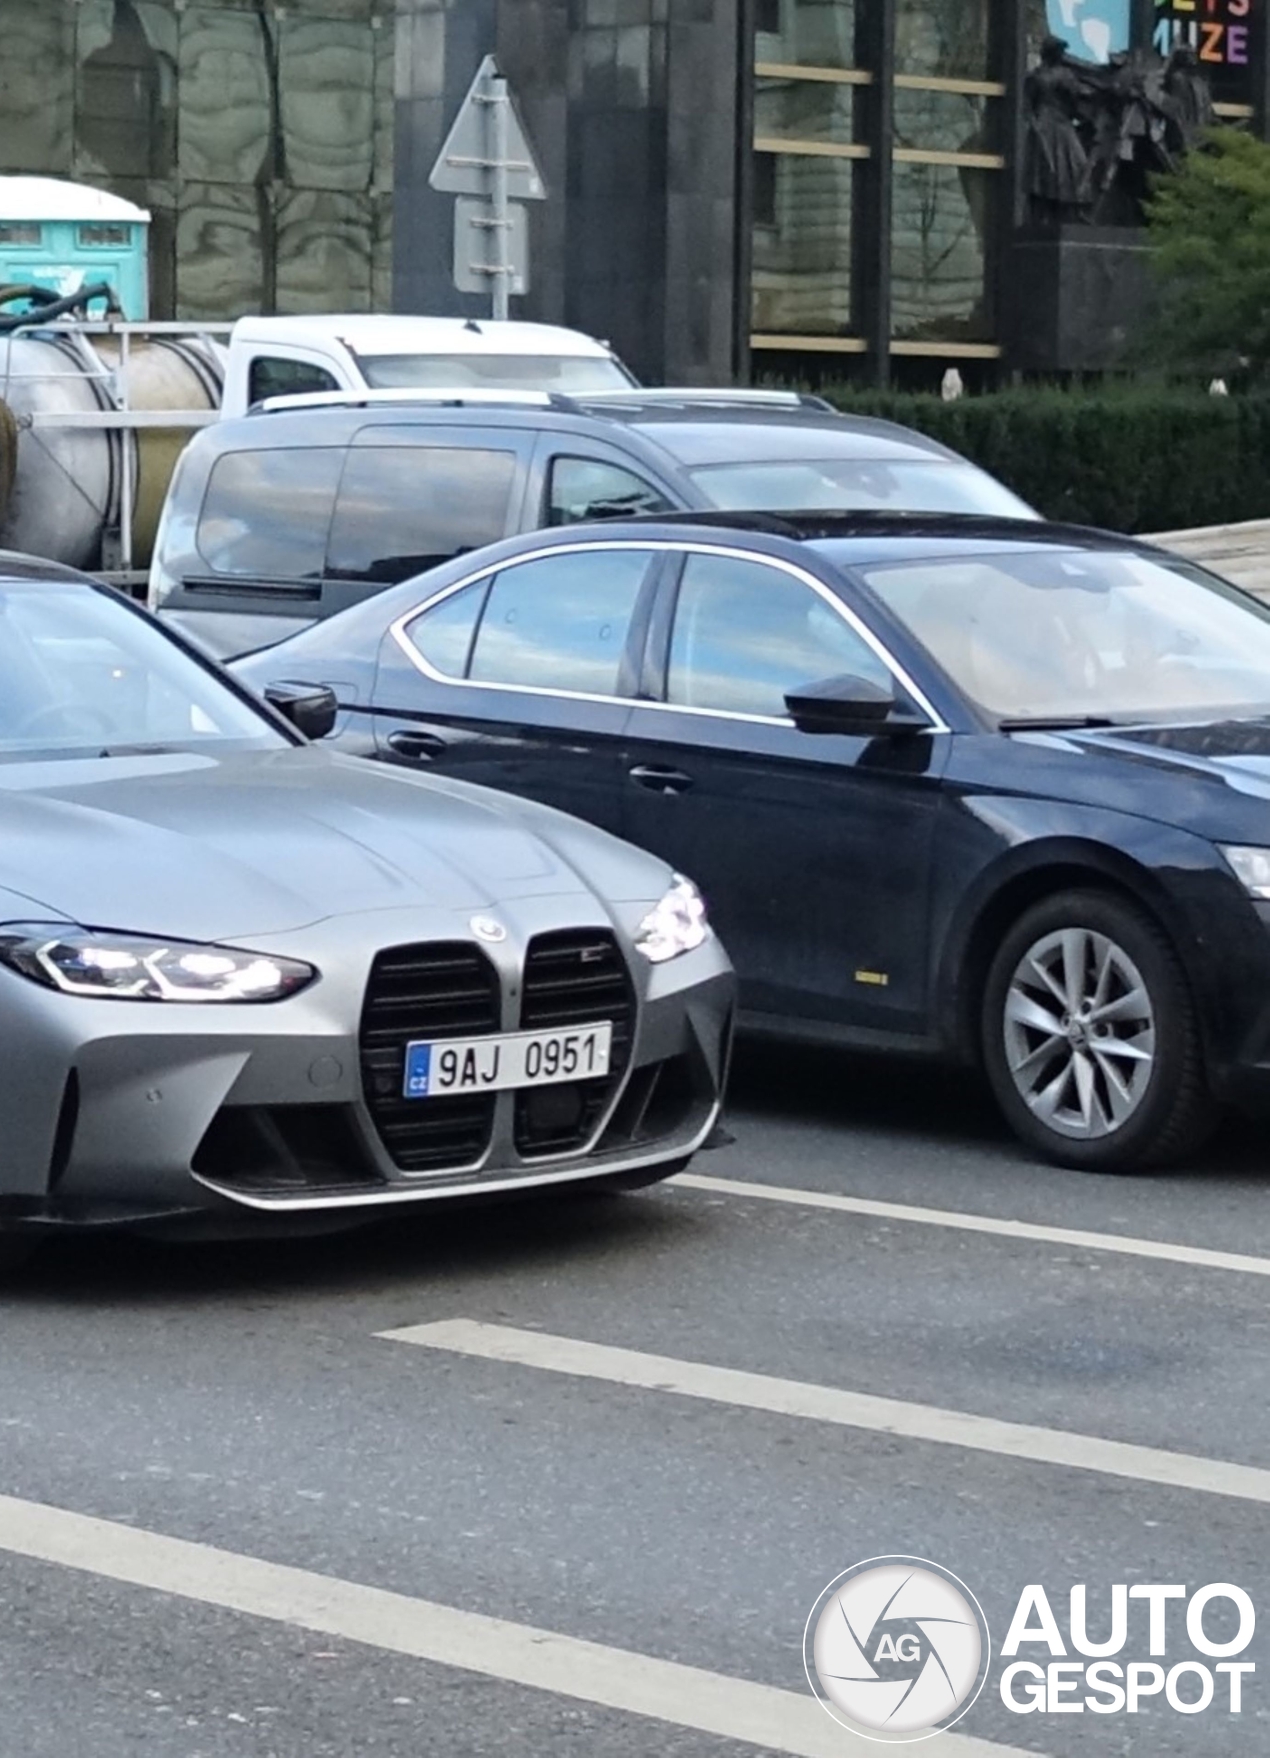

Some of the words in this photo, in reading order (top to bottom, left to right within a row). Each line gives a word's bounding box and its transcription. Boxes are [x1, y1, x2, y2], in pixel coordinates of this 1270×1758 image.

[438, 1044, 501, 1088] 9AJ
[524, 1032, 596, 1079] 0951
[409, 1076, 428, 1090] CZ
